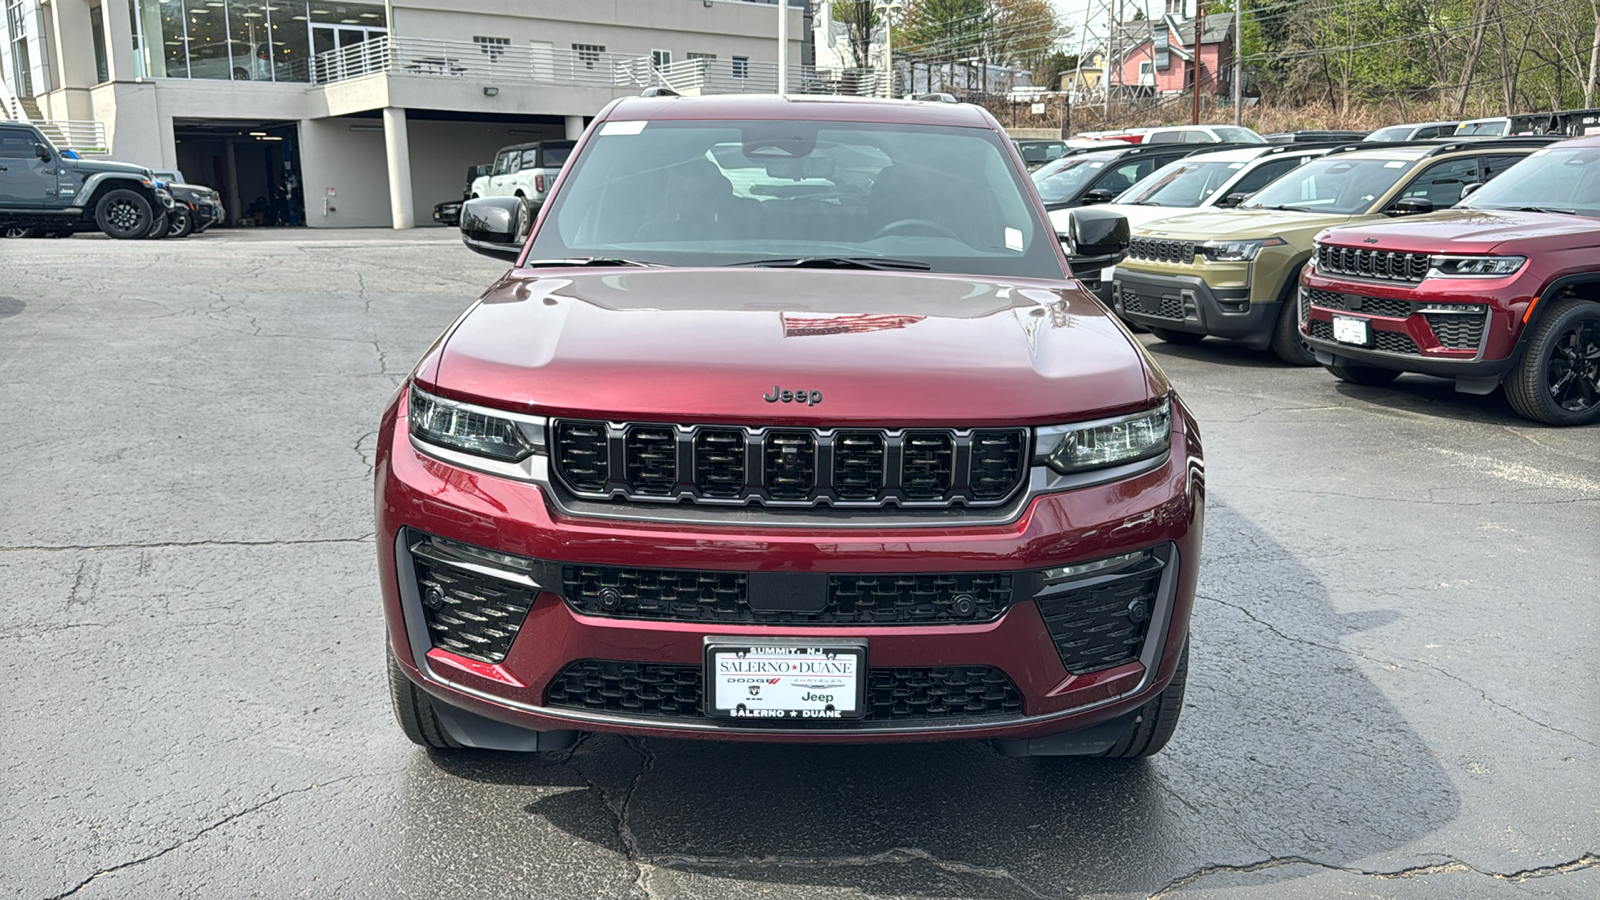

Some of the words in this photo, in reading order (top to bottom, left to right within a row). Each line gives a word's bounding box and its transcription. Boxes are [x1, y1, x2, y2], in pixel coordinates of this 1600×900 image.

[762, 385, 823, 407] Jeep
[807, 647, 823, 655] NJ
[720, 661, 790, 673] SALERNO
[799, 662, 853, 674] DUANE
[801, 691, 834, 704] Jeep
[730, 709, 785, 718] SALERNO
[802, 710, 842, 718] DUANE
